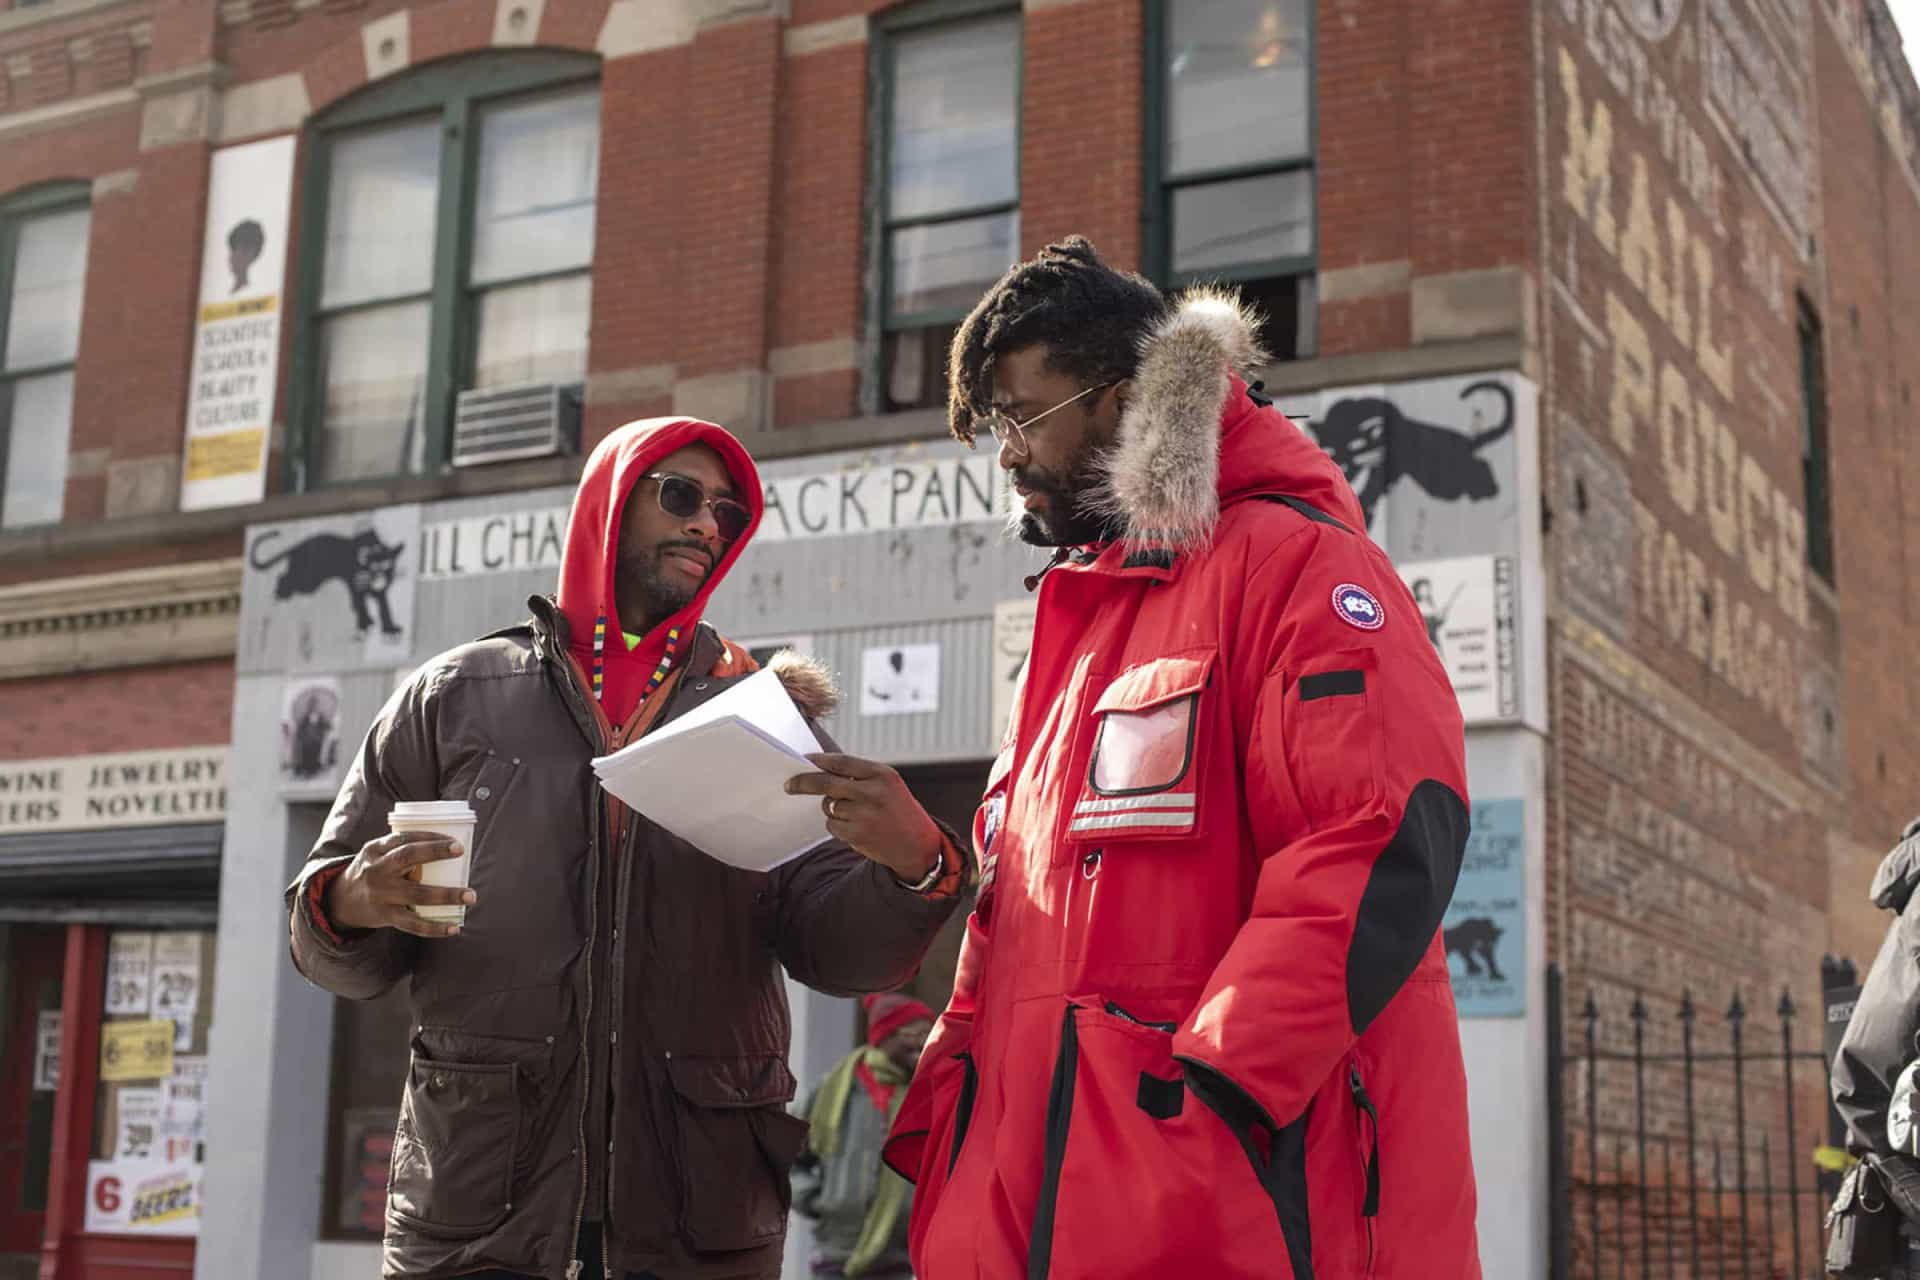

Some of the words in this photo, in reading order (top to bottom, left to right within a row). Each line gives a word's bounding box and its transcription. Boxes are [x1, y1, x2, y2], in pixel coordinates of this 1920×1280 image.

[1604, 288, 1807, 632] POUCH
[418, 527, 464, 575] ILL
[482, 515, 564, 569] CHA
[764, 476, 869, 536] ACK
[87, 759, 220, 796] JEWELRY
[94, 1175, 122, 1214] 6
